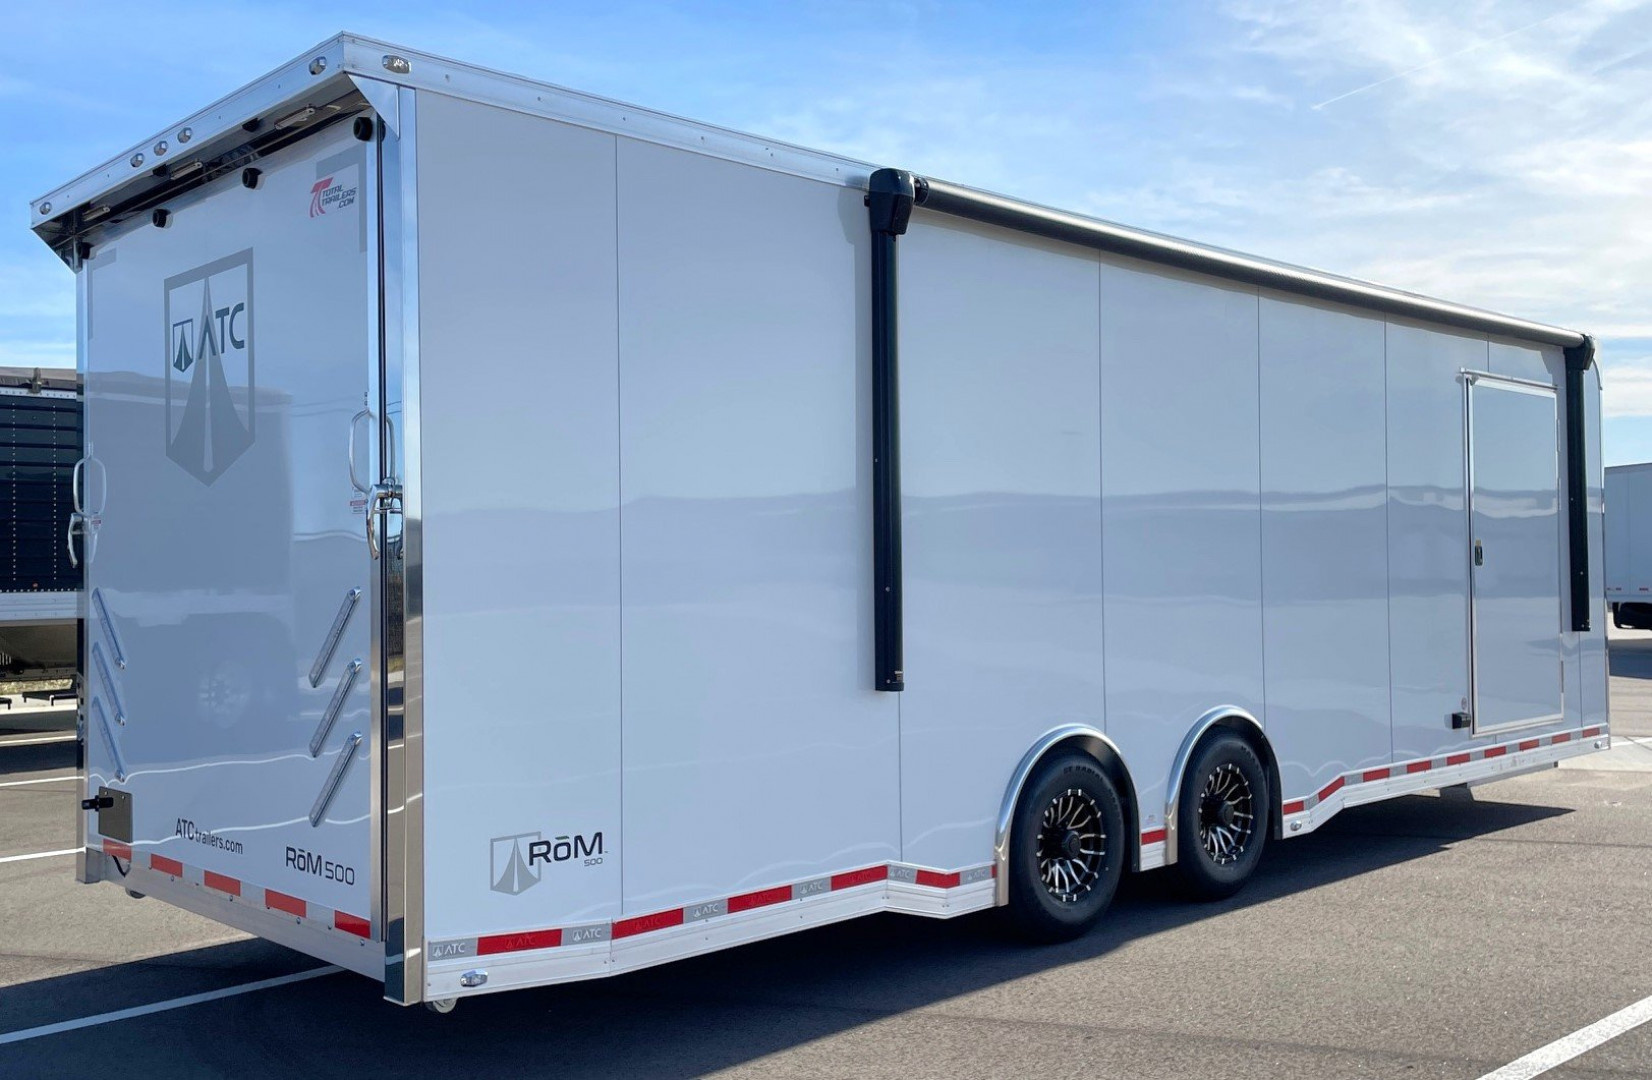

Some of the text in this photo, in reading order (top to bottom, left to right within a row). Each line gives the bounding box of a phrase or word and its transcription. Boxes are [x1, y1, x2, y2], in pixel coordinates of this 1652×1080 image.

[198, 302, 245, 360] ATC
[175, 817, 244, 855] ATCtrailers.com
[583, 857, 603, 867] 500
[325, 861, 355, 886] 500
[807, 881, 823, 892] ATC
[702, 903, 719, 915] ATC
[582, 927, 602, 940] ATC
[443, 942, 466, 955] ATC
